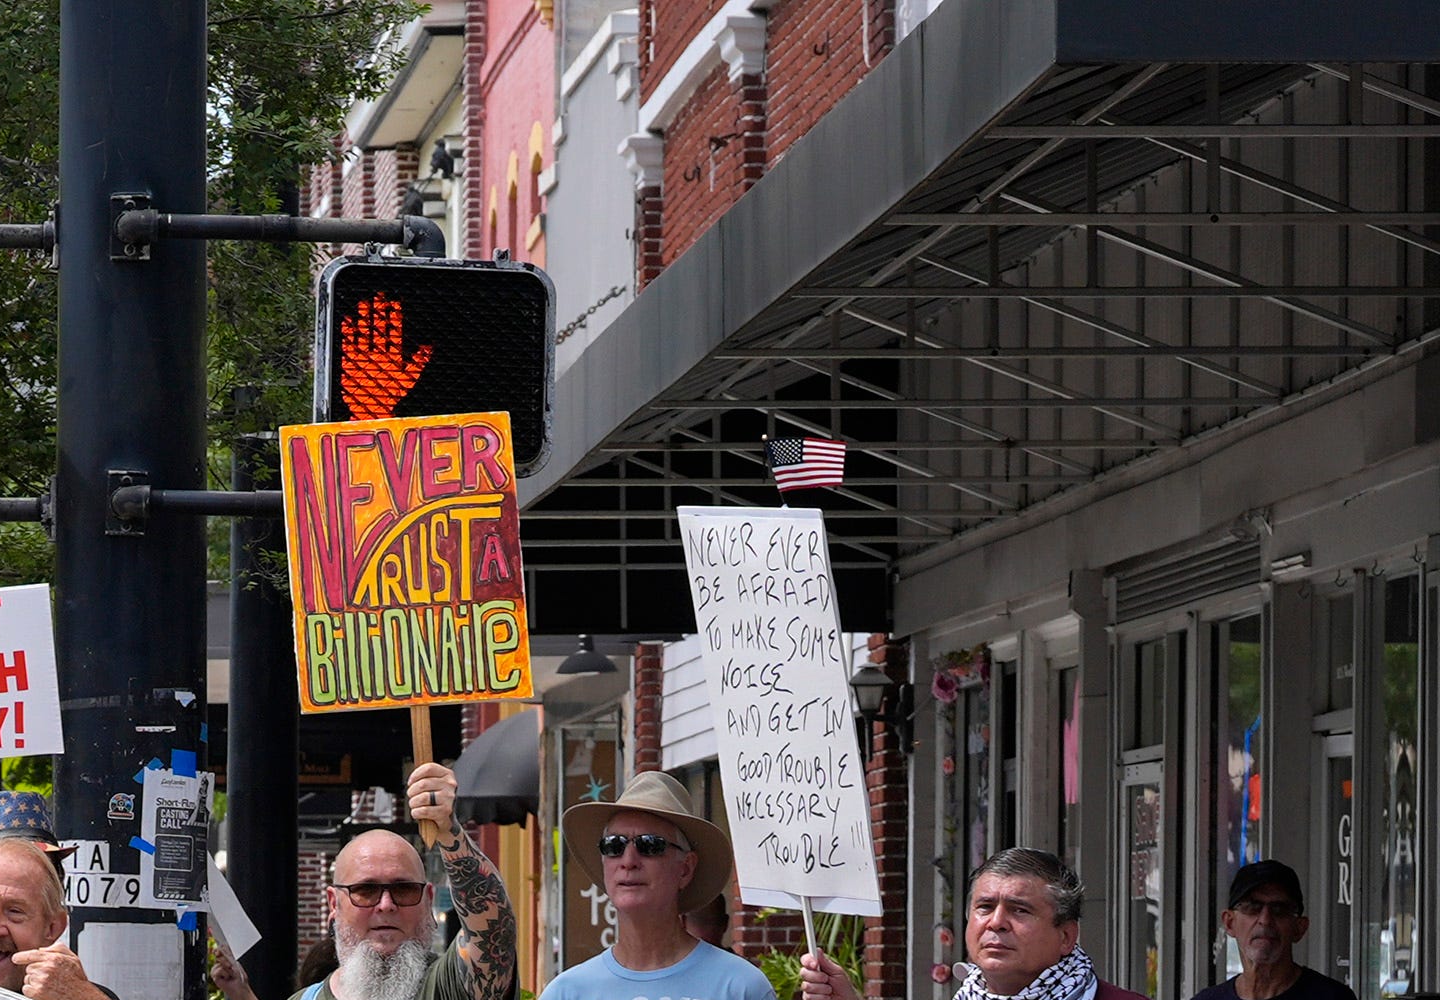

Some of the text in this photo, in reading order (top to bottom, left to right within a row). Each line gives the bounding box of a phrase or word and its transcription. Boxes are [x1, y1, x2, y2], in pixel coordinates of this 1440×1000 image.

[290, 424, 509, 612] NEVER
[353, 494, 509, 606] TRUST A
[688, 522, 826, 573] NEVER EVER
[694, 573, 830, 611] BE AFRAID
[705, 614, 839, 666] TO MAKE SOME
[721, 658, 793, 697] NOISE
[727, 697, 847, 738] AND GET IN
[737, 751, 773, 783] GOOD
[160, 818, 182, 829] CALL
[736, 791, 840, 835] NECESSARY
